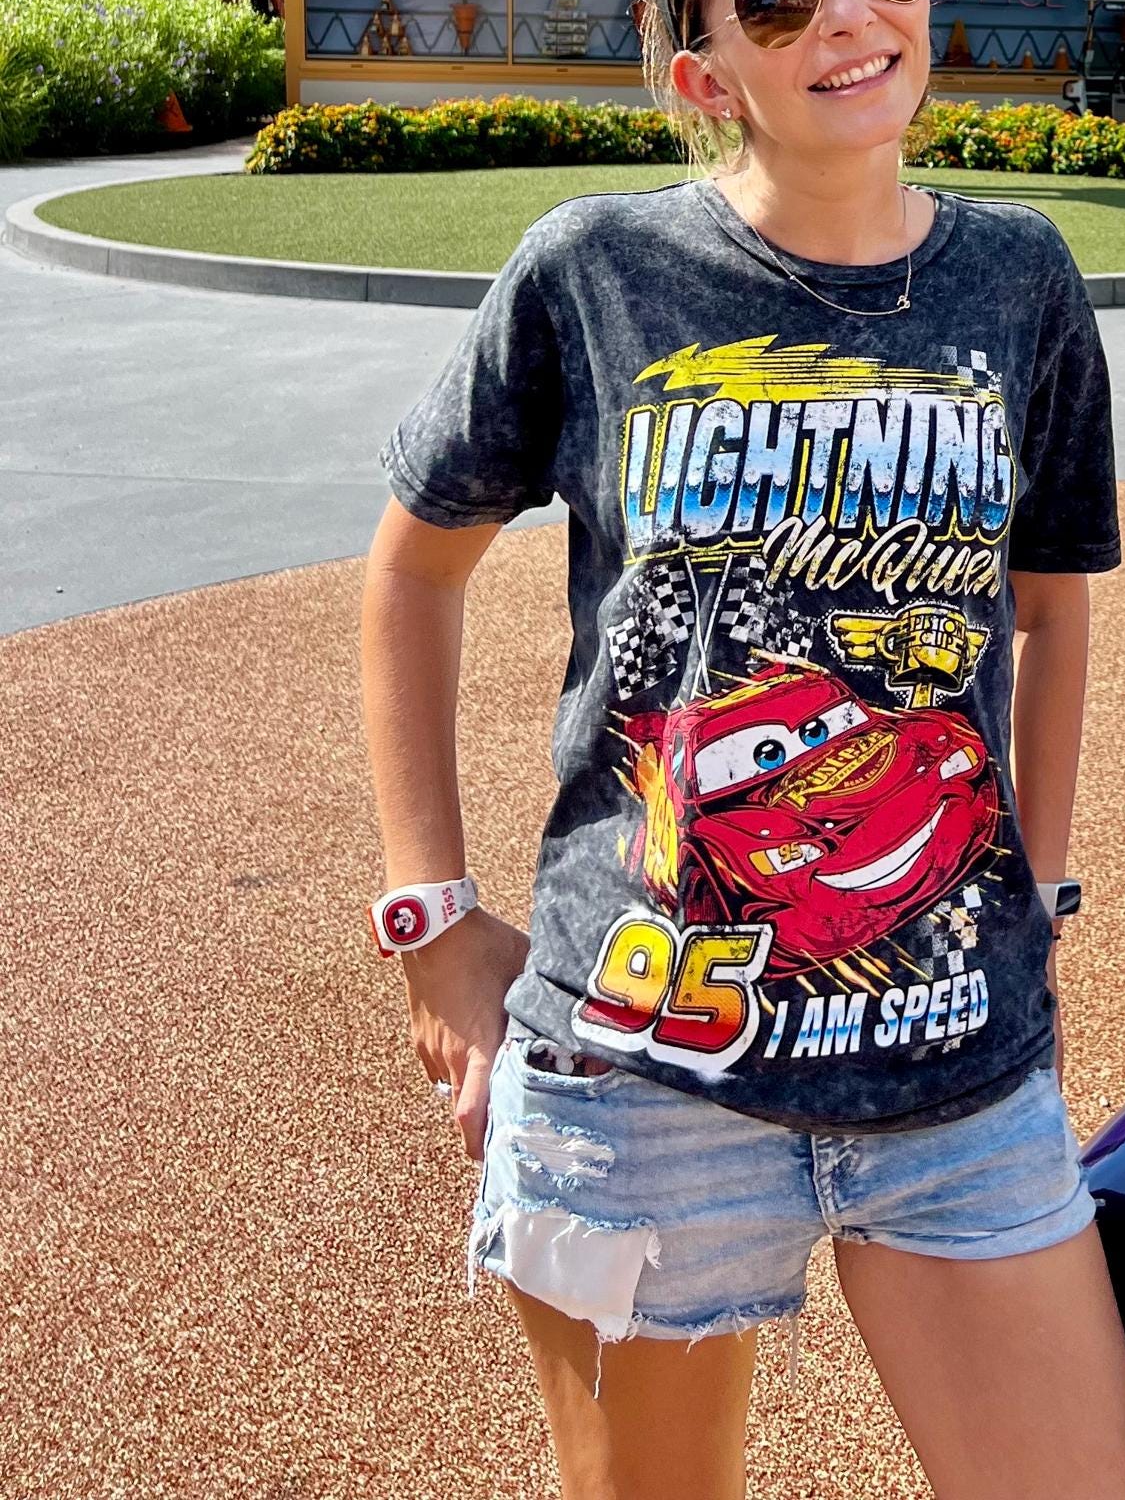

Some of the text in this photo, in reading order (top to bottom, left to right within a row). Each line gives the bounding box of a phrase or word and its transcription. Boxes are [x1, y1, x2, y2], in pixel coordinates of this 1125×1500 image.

[625, 398, 1012, 549] LIGHTNING
[763, 515, 1000, 605] McQueen
[912, 614, 966, 639] PISTON
[919, 629, 955, 650] CUP
[779, 842, 803, 864] 95
[442, 887, 457, 916] 1955
[575, 915, 766, 1060] 95
[764, 969, 989, 1058] I AM SPEED
